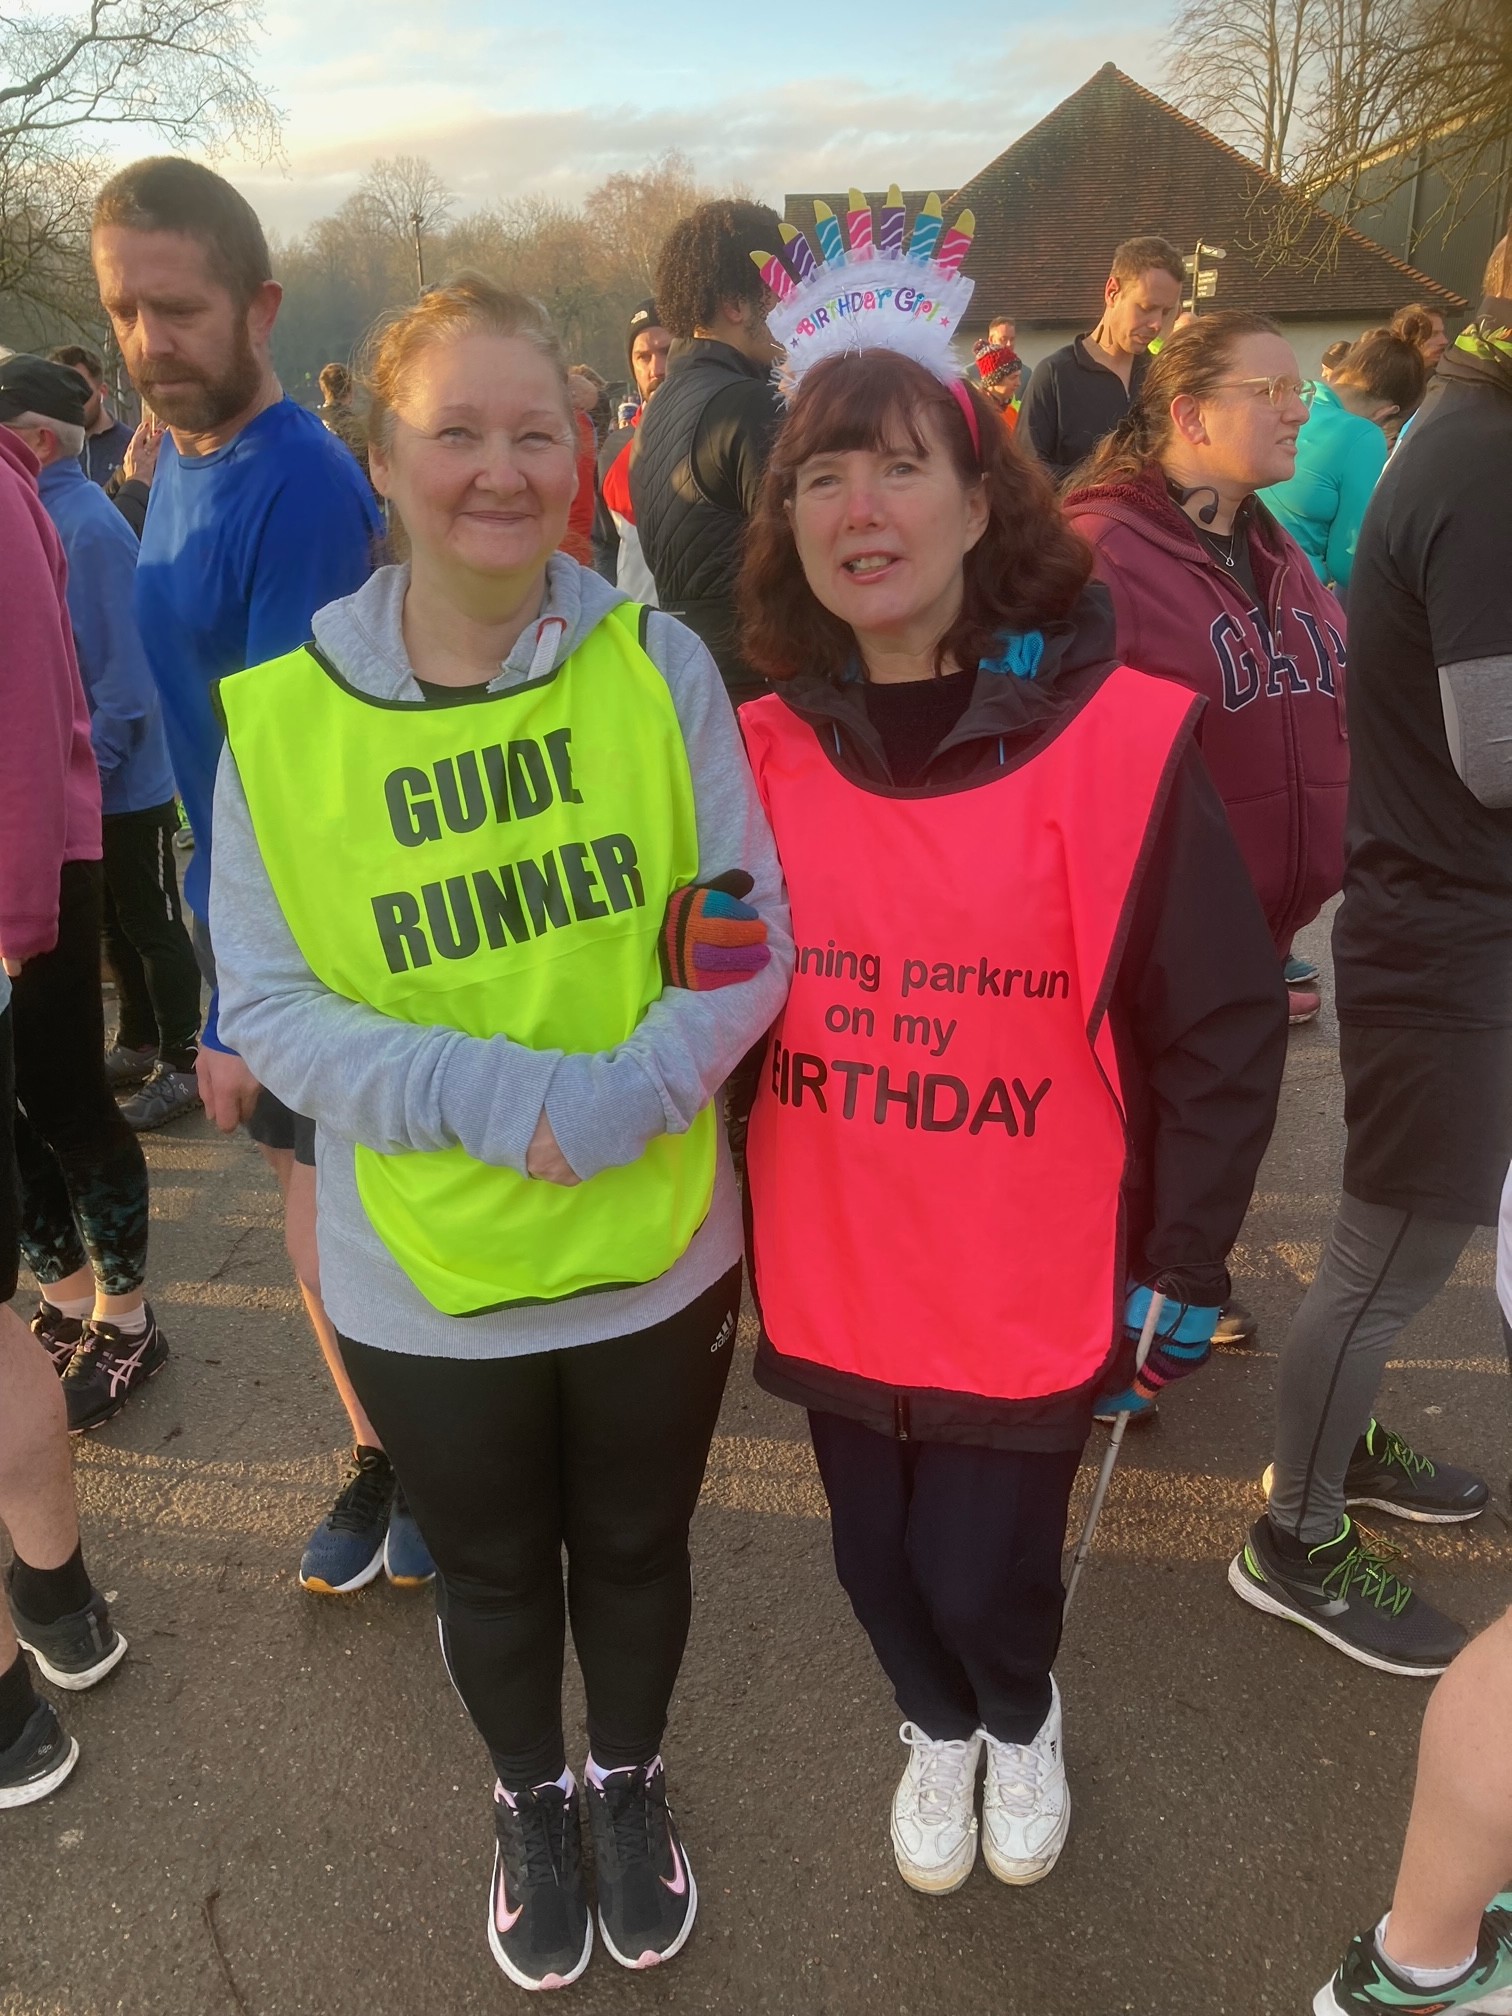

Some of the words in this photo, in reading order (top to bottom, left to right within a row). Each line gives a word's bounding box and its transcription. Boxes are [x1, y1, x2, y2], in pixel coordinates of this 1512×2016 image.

[371, 833, 645, 974] RUNNER
[901, 957, 1069, 999] parkrun
[825, 1004, 875, 1037] on
[893, 1013, 957, 1056] my
